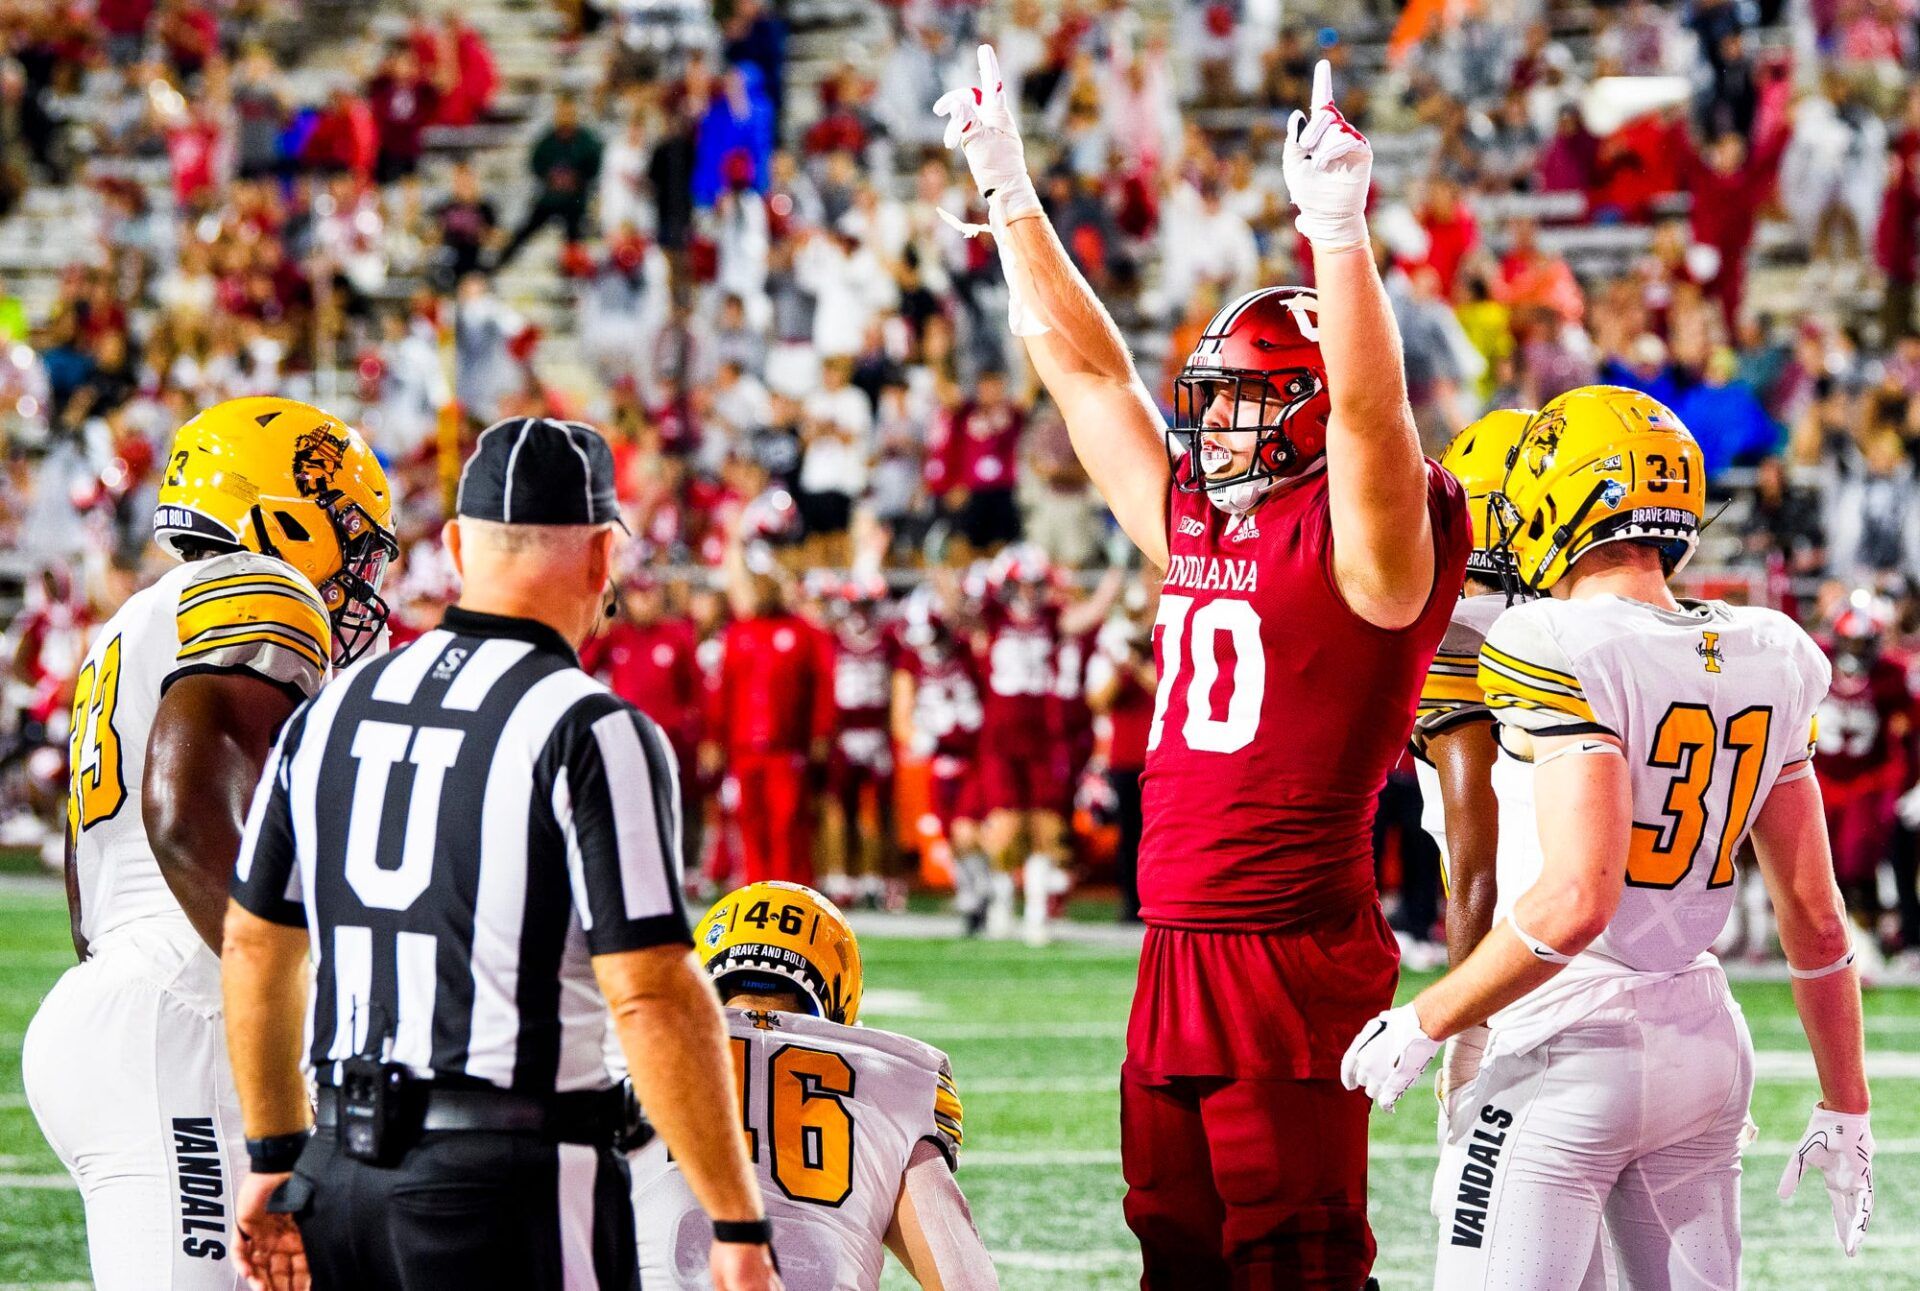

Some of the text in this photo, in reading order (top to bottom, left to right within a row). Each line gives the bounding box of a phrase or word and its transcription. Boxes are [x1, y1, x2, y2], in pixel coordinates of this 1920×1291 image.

[160, 451, 189, 487] 3
[1646, 455, 1690, 494] 31
[169, 509, 192, 528] BOLD
[1632, 509, 1663, 523] BRAVE
[1664, 509, 1680, 523] AND
[1163, 554, 1258, 592] INDIANA
[1146, 594, 1266, 754] 70
[1625, 701, 1773, 890] 31
[344, 719, 466, 911] U
[744, 901, 805, 936] 46
[729, 945, 807, 969] BRAVE AND BOLD
[172, 1117, 226, 1260] VANDALS
[1451, 1104, 1513, 1249] VANDALS
